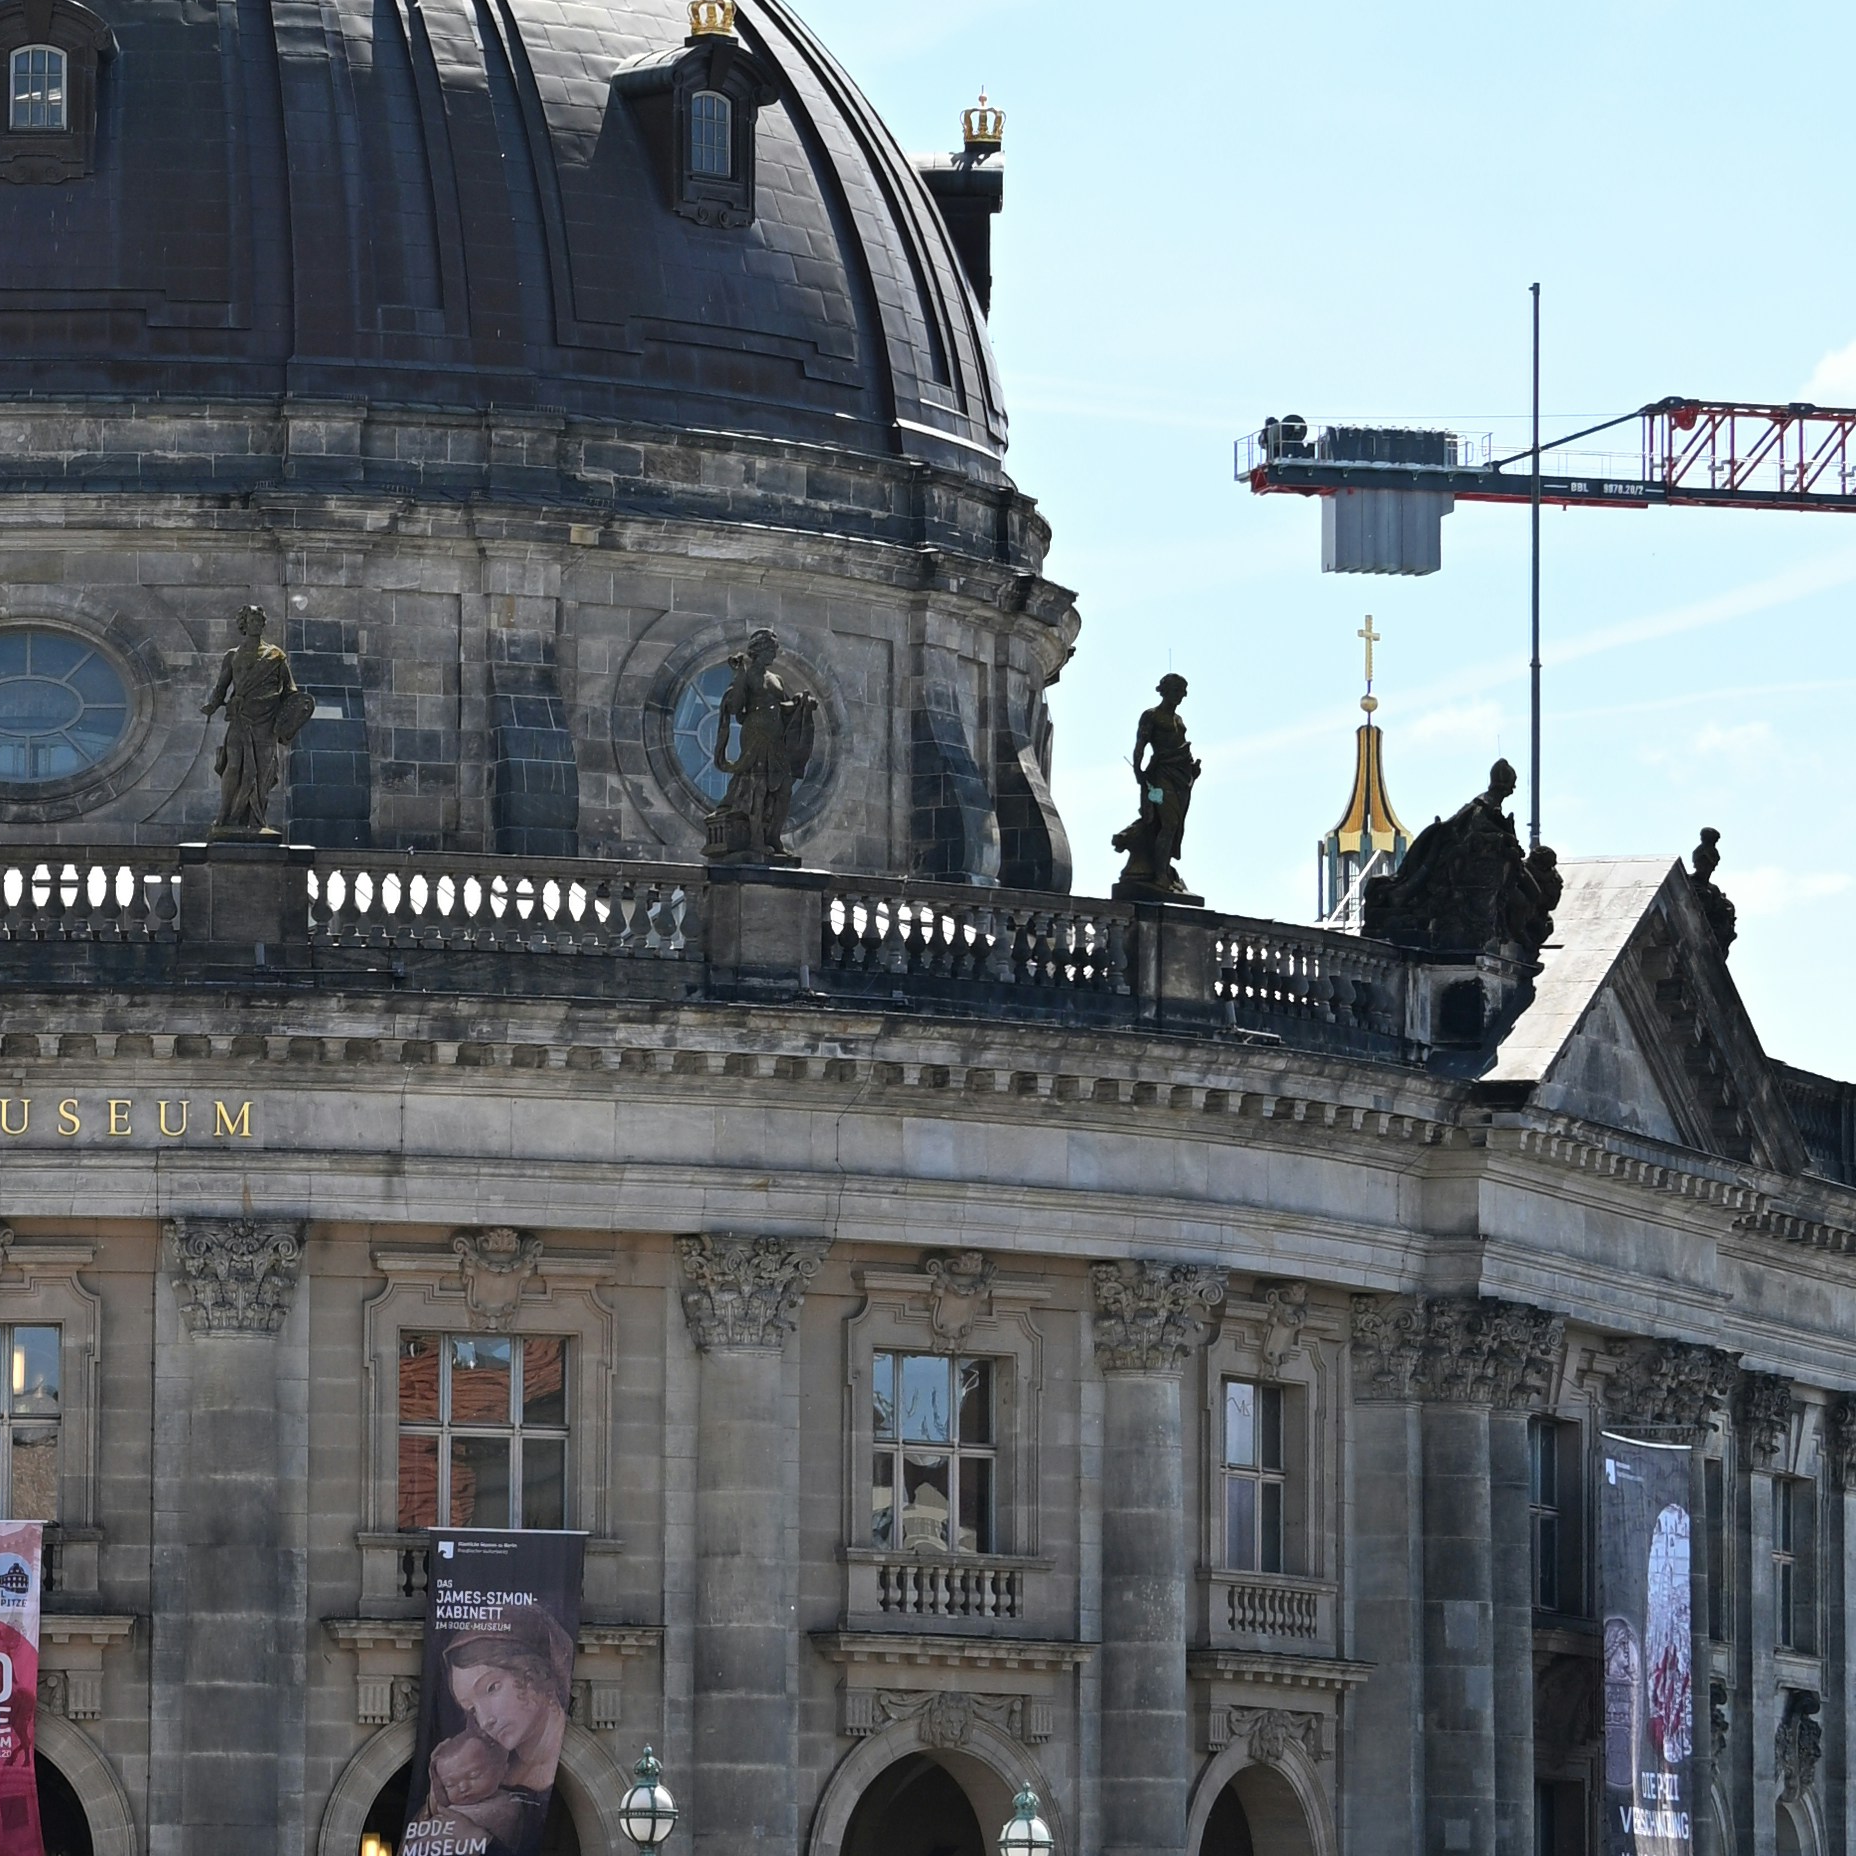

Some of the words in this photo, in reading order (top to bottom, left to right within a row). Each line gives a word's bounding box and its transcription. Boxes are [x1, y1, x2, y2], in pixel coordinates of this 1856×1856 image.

[436, 1579, 453, 1588] DAS
[436, 1590, 538, 1606] JAMES-SIMON-
[436, 1605, 503, 1620] KABINETT
[1641, 1772, 1657, 1800] DIE
[405, 1820, 456, 1839] BODE
